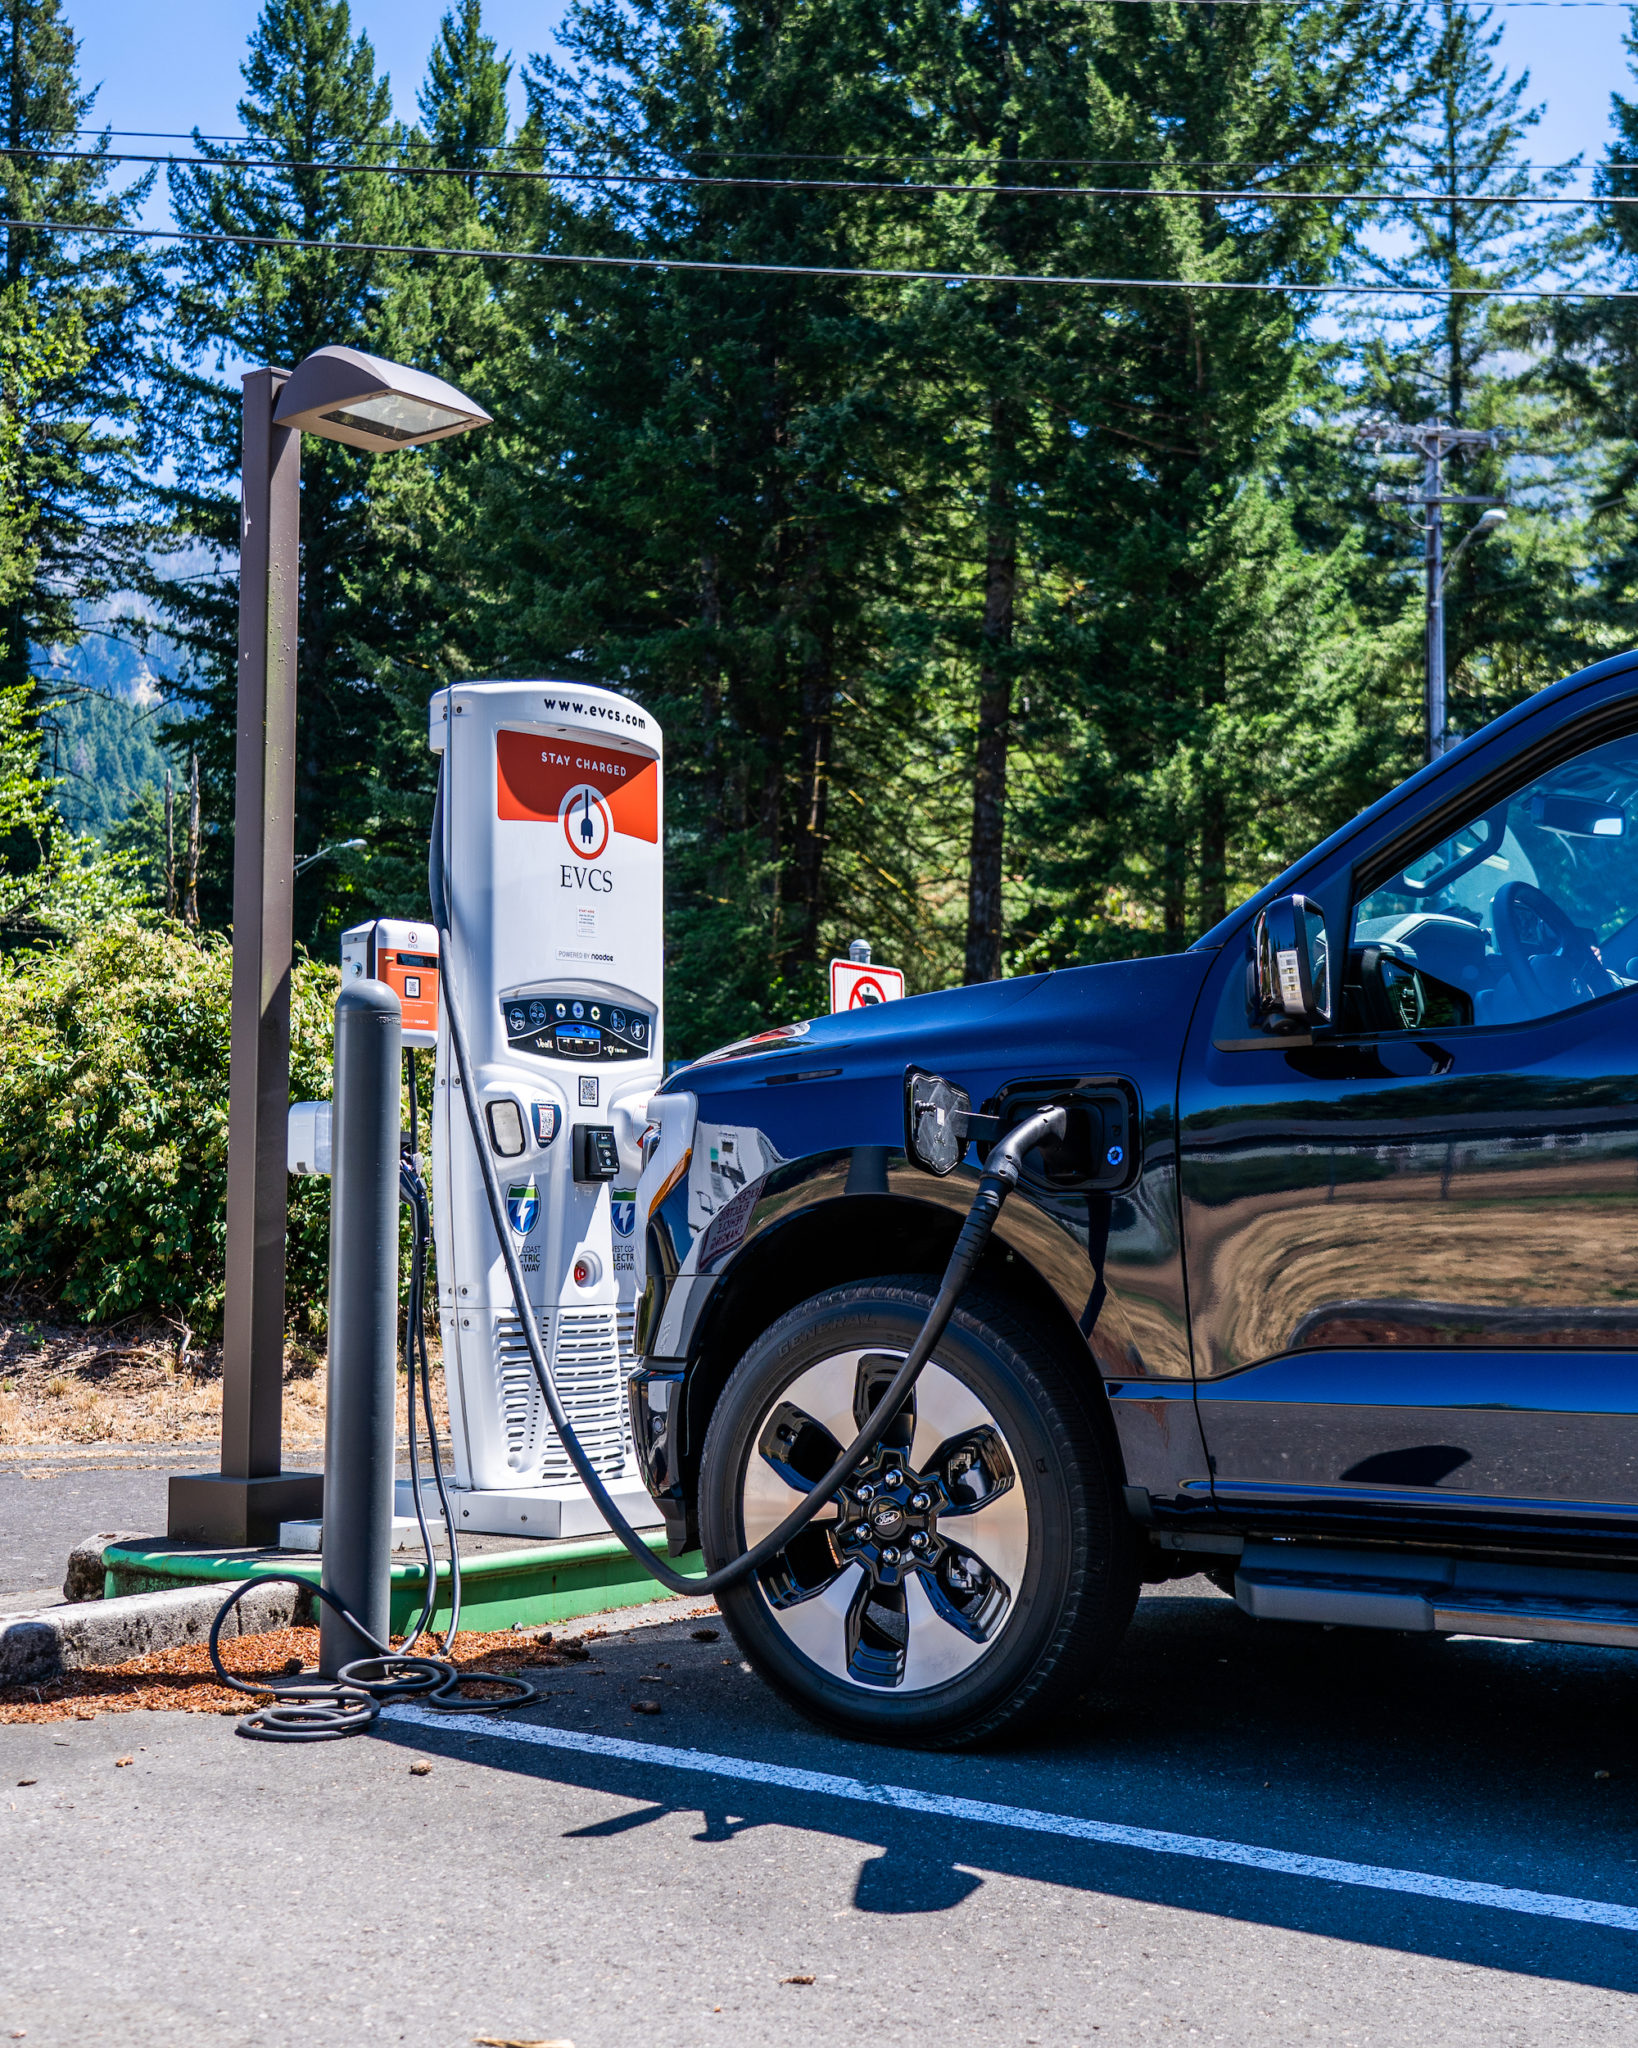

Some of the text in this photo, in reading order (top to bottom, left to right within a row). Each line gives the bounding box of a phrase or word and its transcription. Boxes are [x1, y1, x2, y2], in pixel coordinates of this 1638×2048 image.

[544, 698, 646, 729] www.evcs.com
[541, 751, 627, 777] STAY CHARGED
[560, 864, 613, 893] EVCS
[558, 949, 583, 959] POWERED
[584, 951, 590, 959] BY
[522, 1245, 541, 1253] COAST
[518, 1254, 541, 1263] CTRIC
[613, 1253, 635, 1262] LECTR
[613, 1262, 635, 1271] IGHW
[779, 1311, 874, 1357] GENERAL
[877, 1512, 897, 1525] Ford
